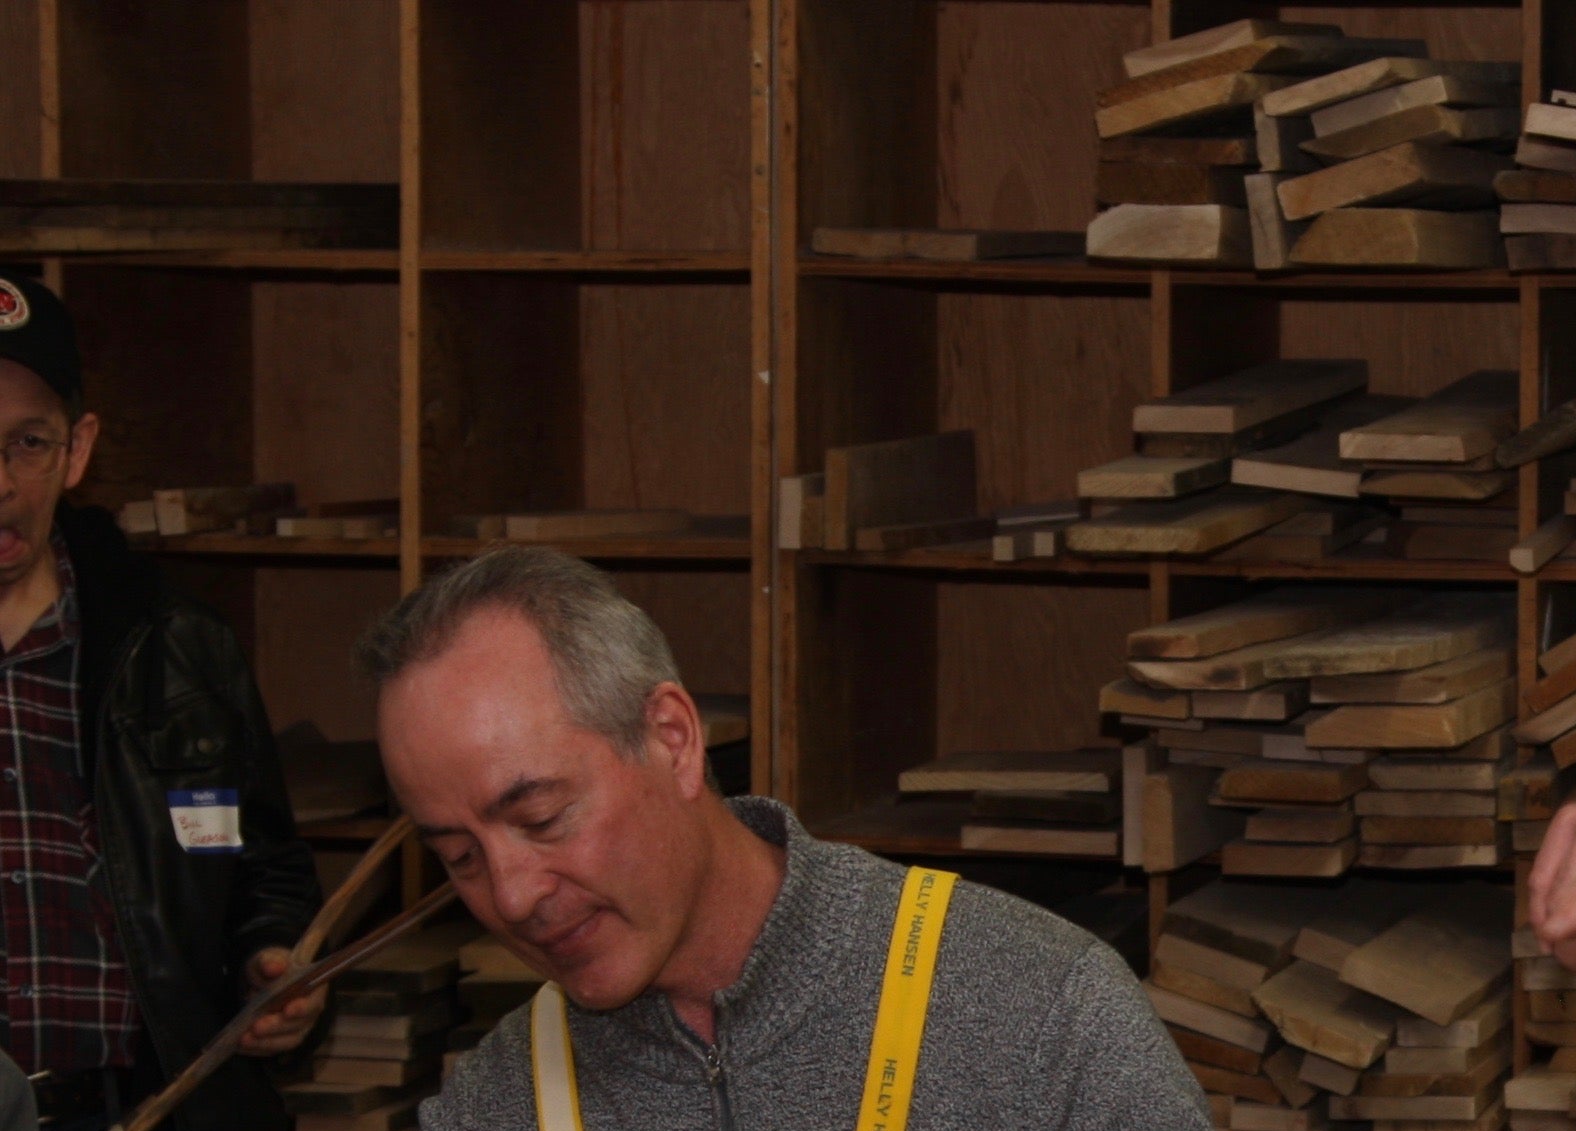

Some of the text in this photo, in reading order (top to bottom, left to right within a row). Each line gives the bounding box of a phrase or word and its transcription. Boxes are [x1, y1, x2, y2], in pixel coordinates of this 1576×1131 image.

[901, 872, 936, 977] HELLY HANSEN
[876, 1058, 898, 1117] HELLY
